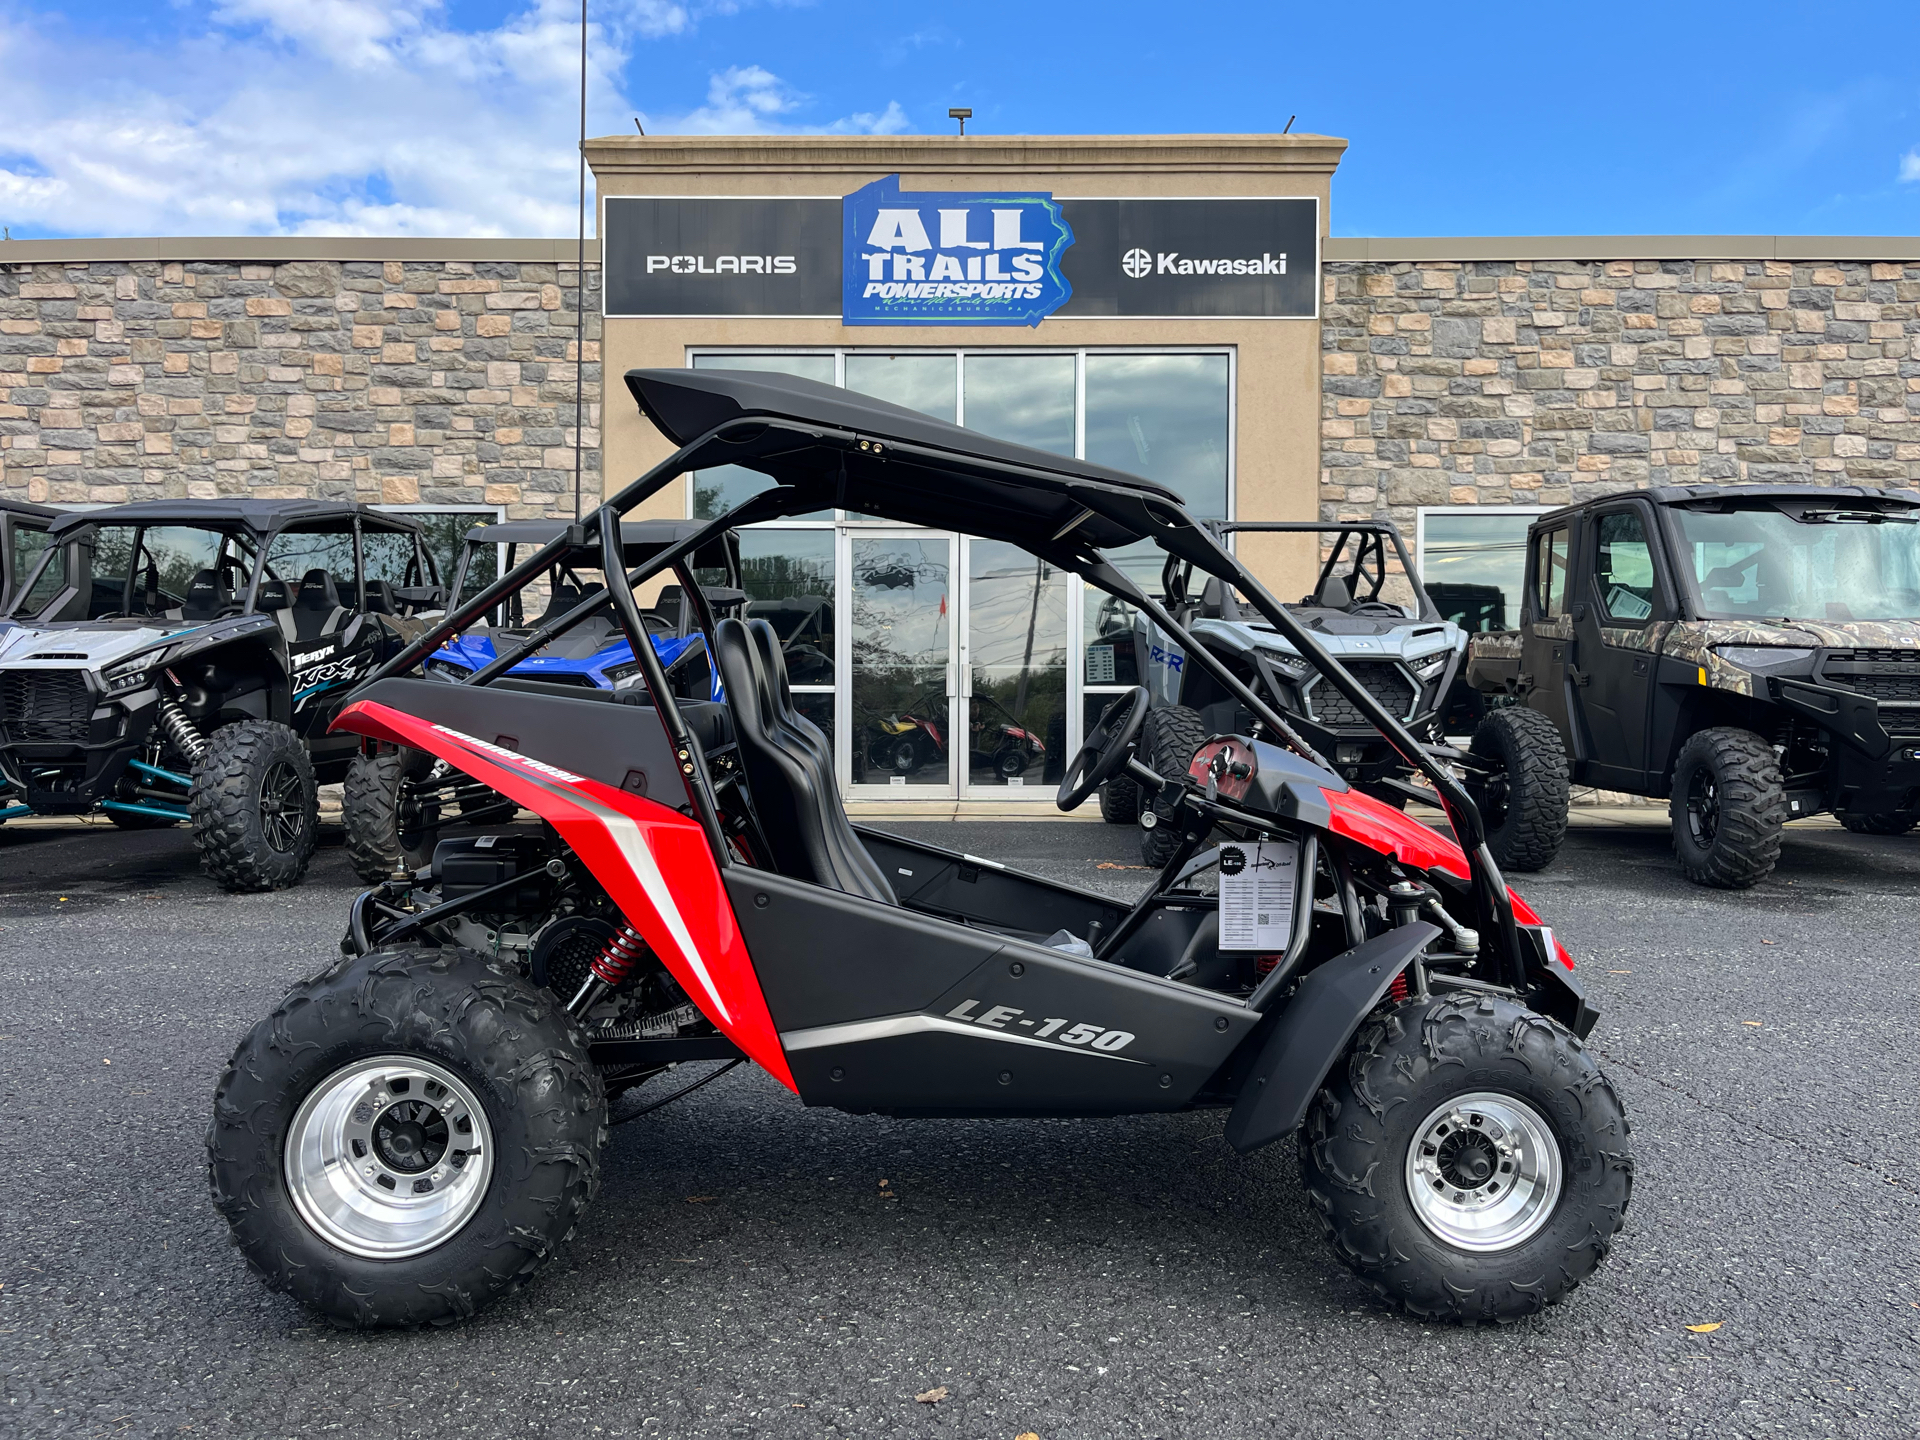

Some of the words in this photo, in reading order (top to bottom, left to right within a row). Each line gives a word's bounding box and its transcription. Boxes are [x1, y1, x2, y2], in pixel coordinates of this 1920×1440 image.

[866, 209, 1044, 253] ALL
[646, 256, 797, 274] POLARIS
[861, 252, 1044, 282] TRAILS
[1157, 253, 1287, 275] Kawasaki
[862, 282, 1043, 299] POWERSPORTS
[1149, 645, 1184, 673] RZR
[1871, 664, 1920, 673] POLA
[944, 998, 1136, 1052] LE-150
